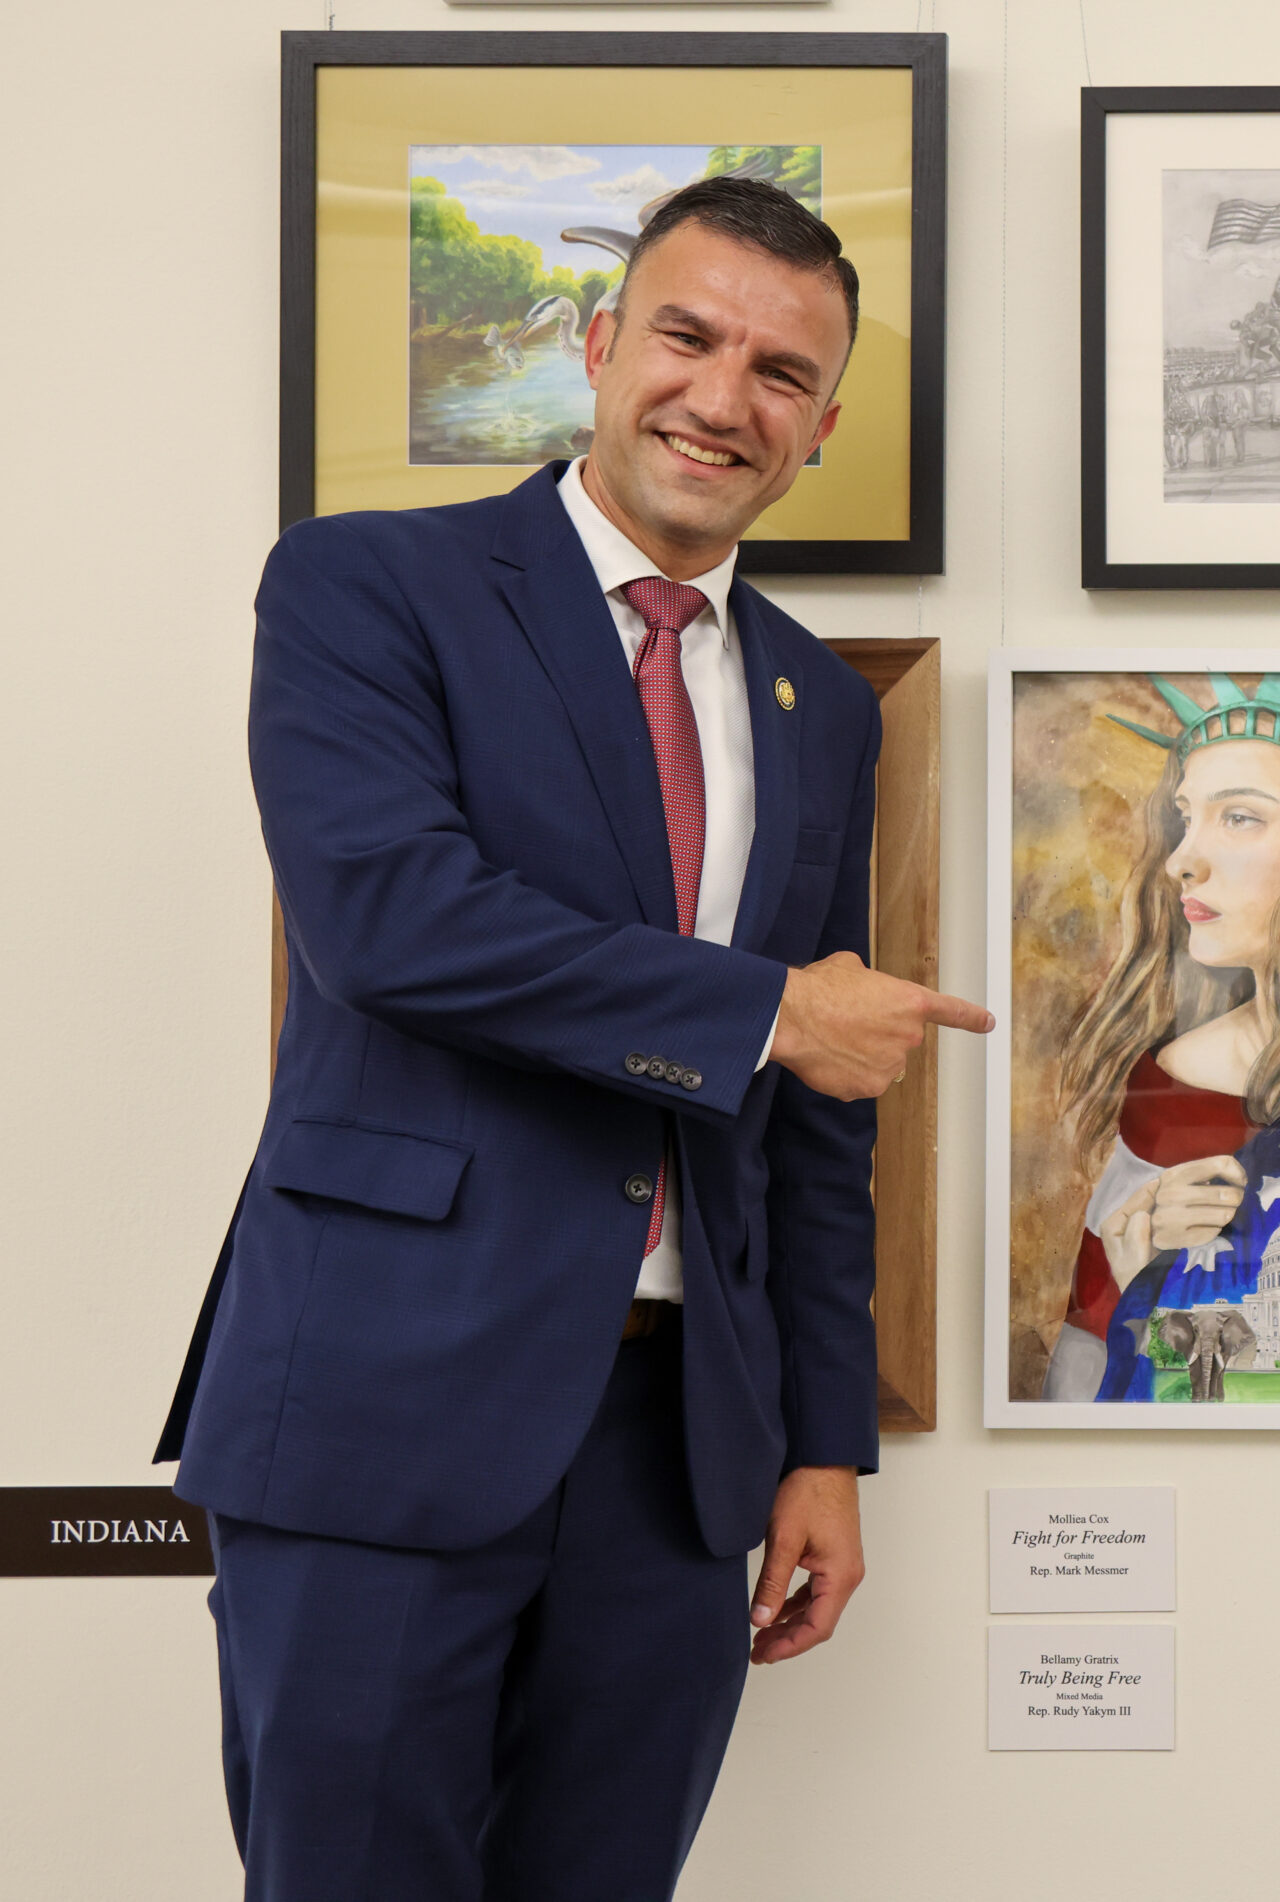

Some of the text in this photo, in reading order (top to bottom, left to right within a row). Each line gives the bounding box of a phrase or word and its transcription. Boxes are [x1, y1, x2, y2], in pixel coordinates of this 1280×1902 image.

[1048, 1513, 1110, 1524] Molliea Cox
[50, 1519, 191, 1543] INDIANA
[1011, 1529, 1146, 1548] Fight for Freedom
[1063, 1552, 1095, 1562] Graphite
[1029, 1565, 1130, 1579] Rep. Mark Messmer
[1040, 1654, 1120, 1667] Bellamy Gratrix
[1018, 1670, 1142, 1689] Truly Being Free
[1056, 1692, 1104, 1701] Mixed Media
[1027, 1705, 1132, 1719] Rep. Rudy Yakym III
